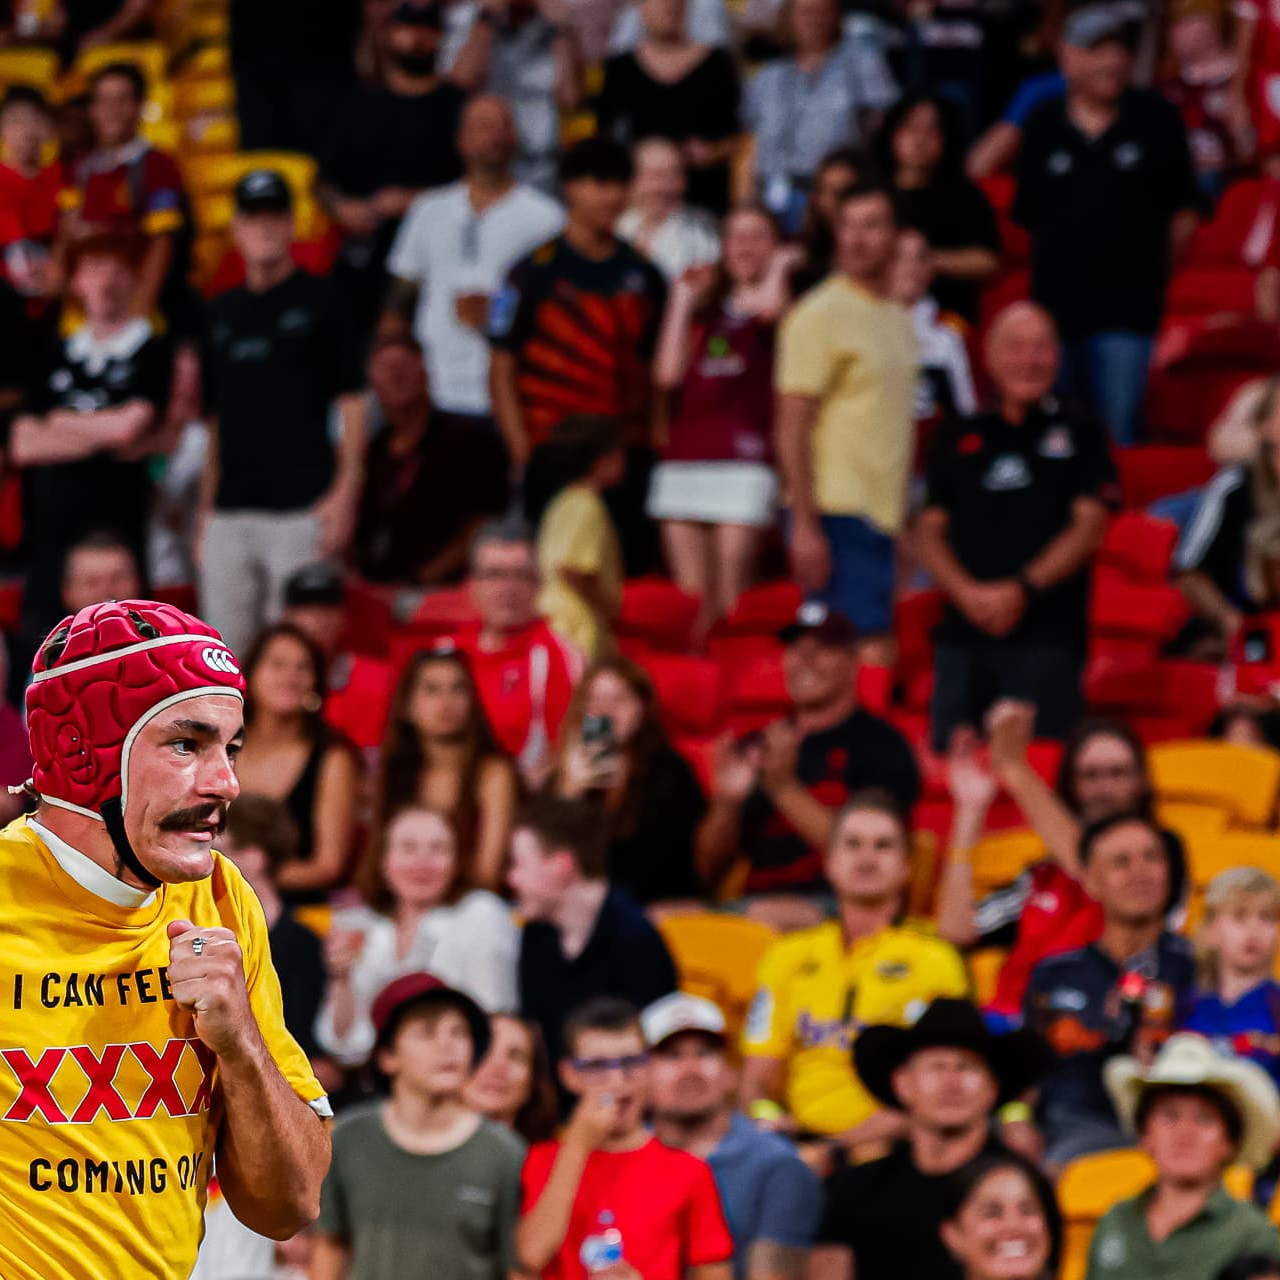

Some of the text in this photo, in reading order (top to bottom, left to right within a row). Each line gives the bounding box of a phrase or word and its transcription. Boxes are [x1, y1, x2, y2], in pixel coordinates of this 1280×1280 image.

[13, 966, 174, 1009] I CAN FEE
[0, 1036, 218, 1125] XXXX
[29, 1157, 167, 1195] COMING
